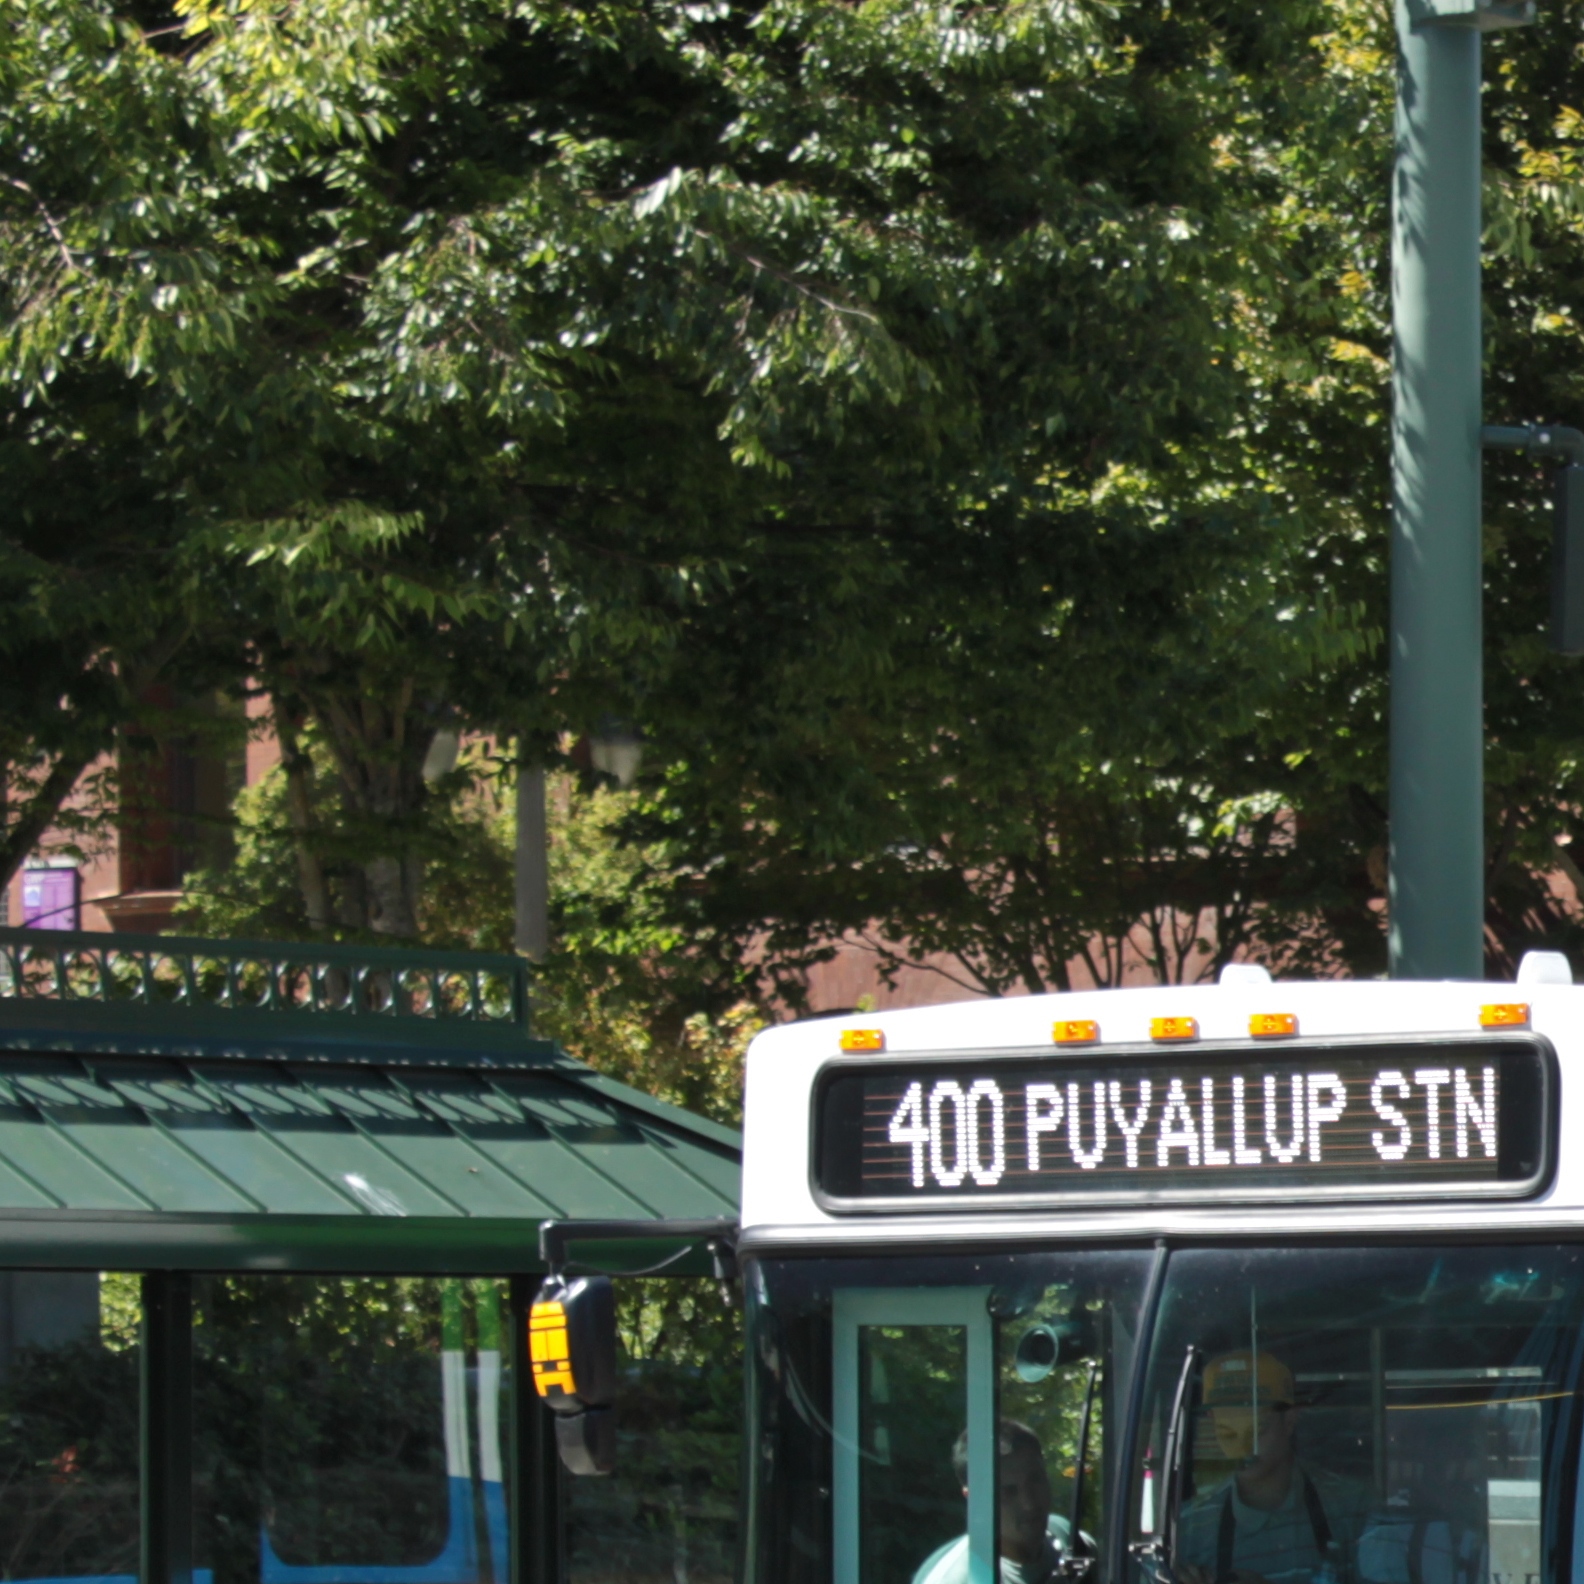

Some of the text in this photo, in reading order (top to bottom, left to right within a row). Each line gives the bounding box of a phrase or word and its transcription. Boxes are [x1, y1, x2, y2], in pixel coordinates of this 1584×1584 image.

[889, 1067, 1496, 1187] 400 PUYALLUP STN
